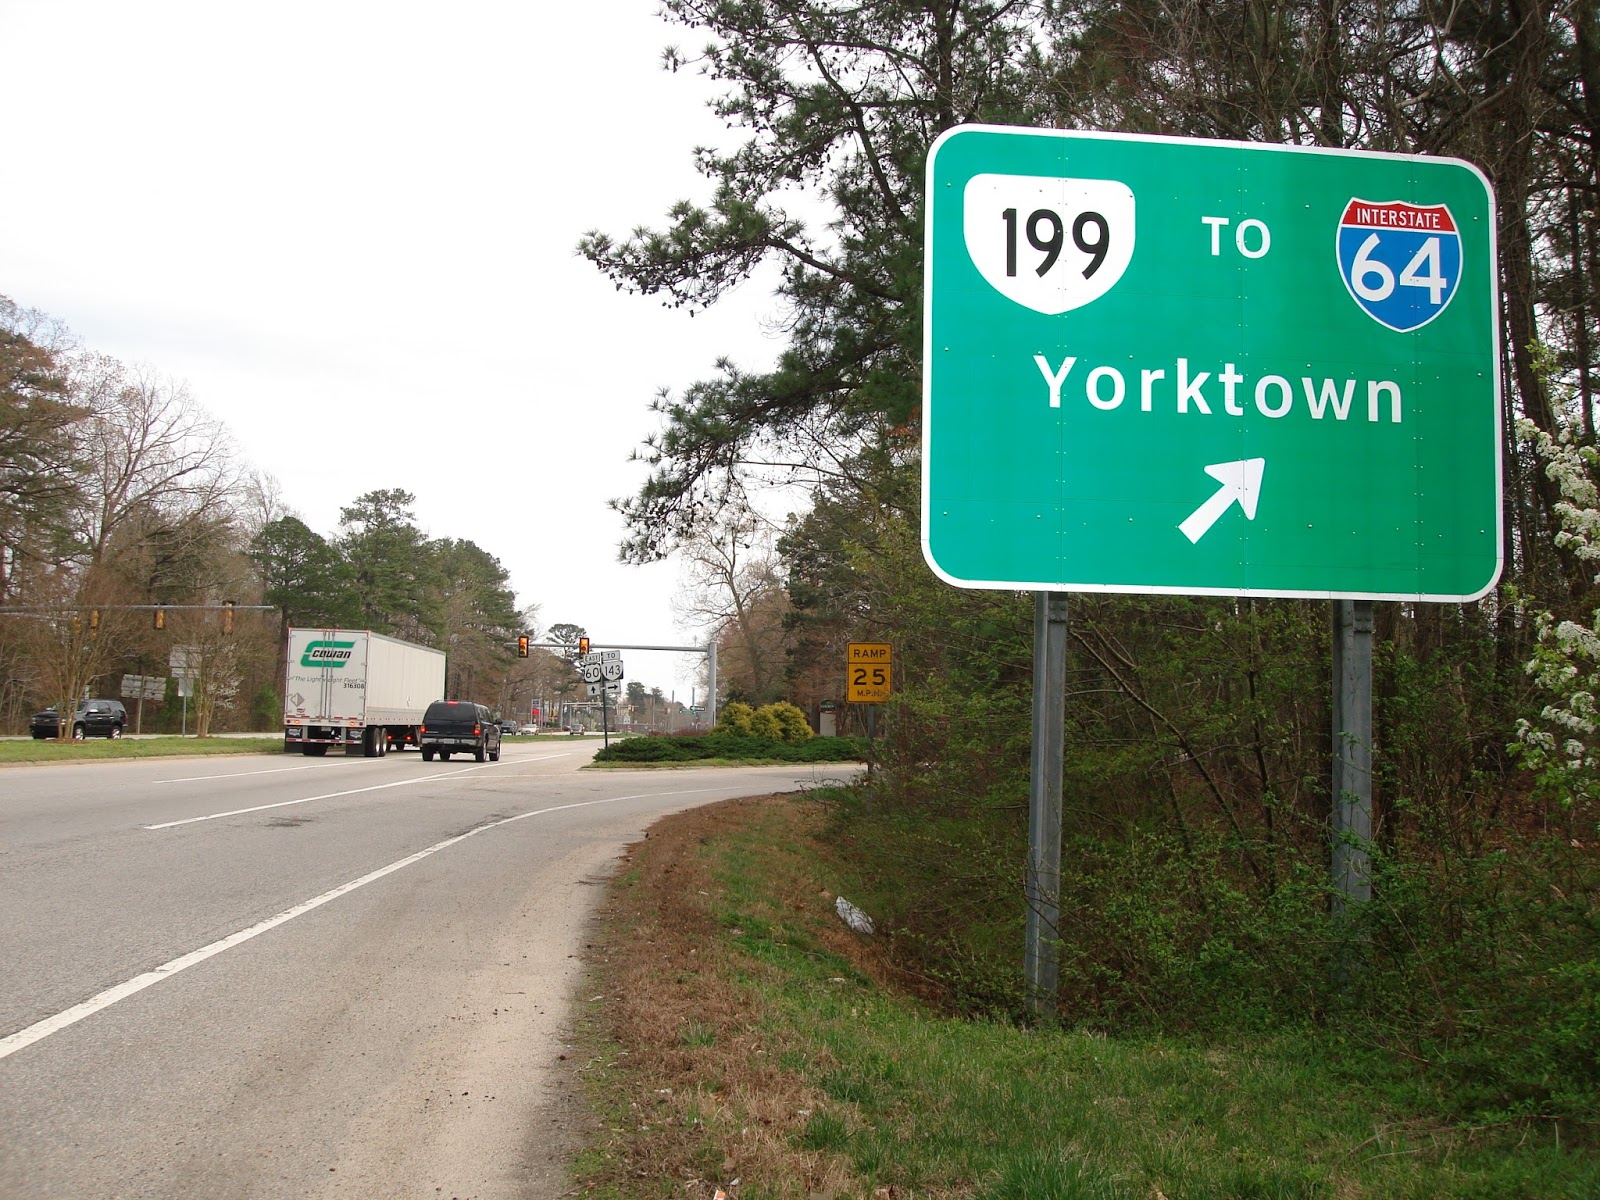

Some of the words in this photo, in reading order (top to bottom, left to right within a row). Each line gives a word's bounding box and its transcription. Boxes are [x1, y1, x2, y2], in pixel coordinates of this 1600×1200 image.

[1356, 207, 1441, 229] INTERSTATE
[1002, 208, 1110, 280] 199
[1201, 216, 1271, 259] TO
[1350, 232, 1447, 305] 64
[1033, 355, 1403, 423] Yorktown
[853, 649, 887, 658] RAMP
[585, 667, 599, 678] 60
[605, 665, 620, 676] 143
[853, 668, 886, 686] 25
